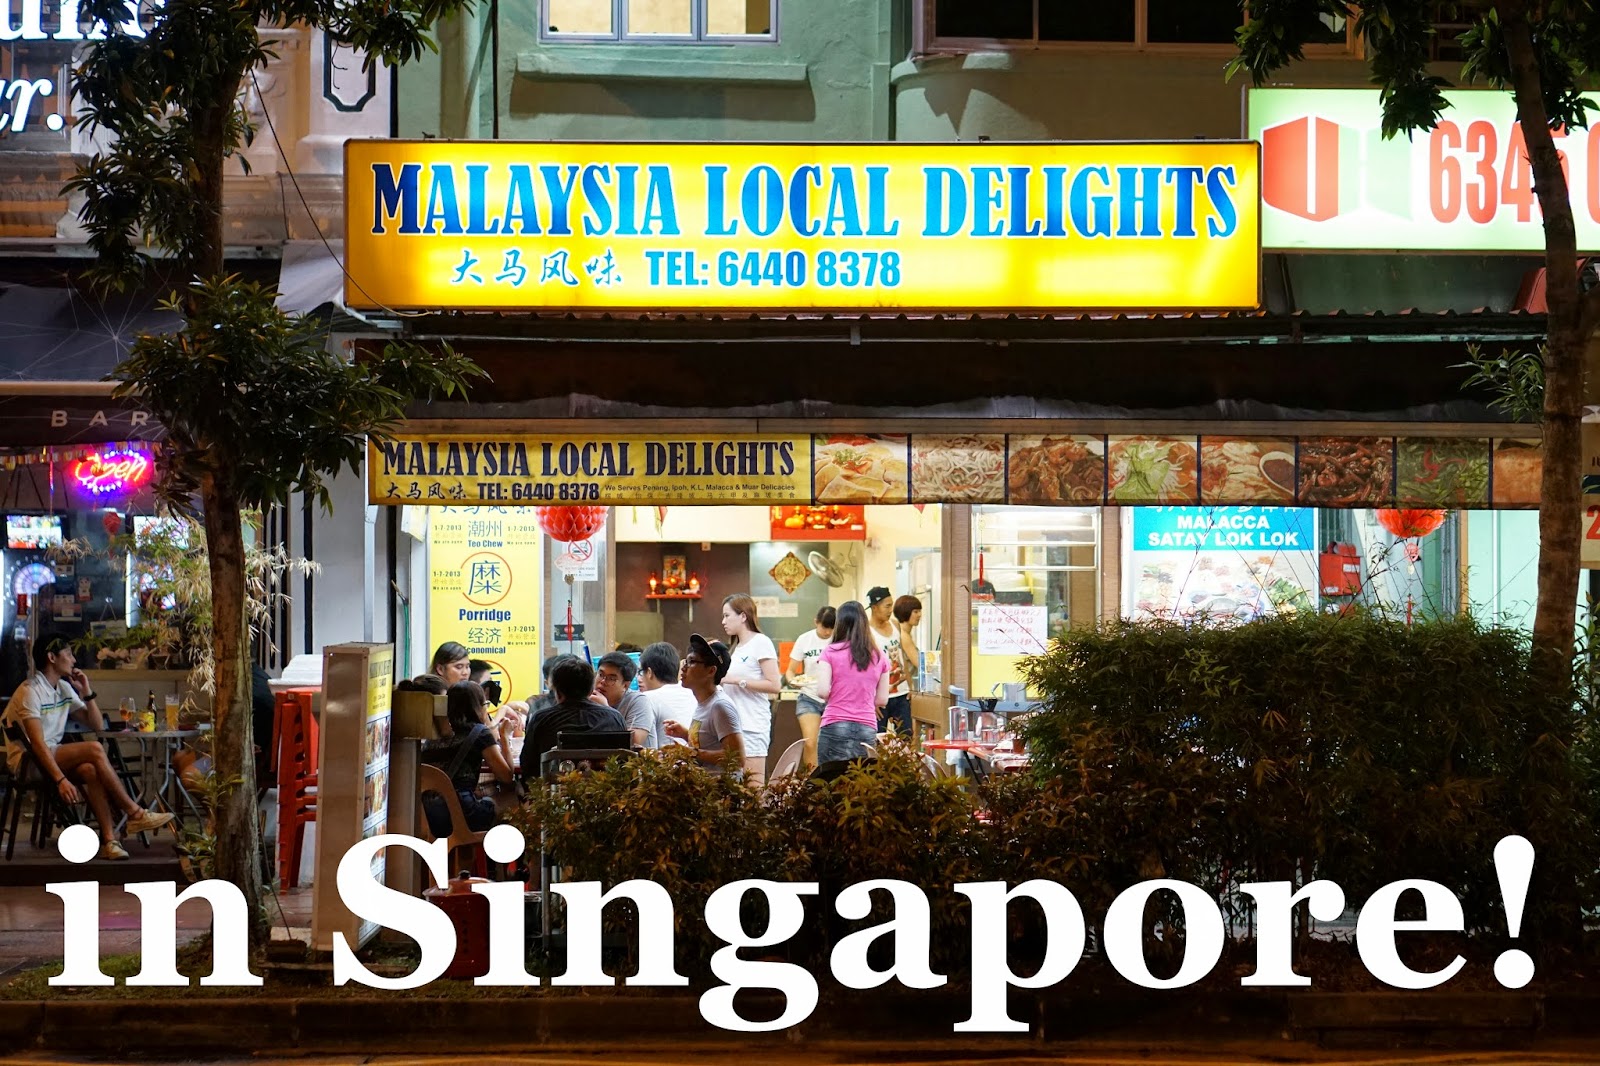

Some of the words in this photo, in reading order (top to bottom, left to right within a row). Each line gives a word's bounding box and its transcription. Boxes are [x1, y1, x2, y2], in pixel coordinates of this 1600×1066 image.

[371, 163, 681, 236] MALAYSIA
[704, 165, 900, 237] LOCAL
[922, 165, 1238, 238] DELIGHTS
[451, 248, 622, 286] 大马风味
[645, 250, 708, 286] TEL:
[717, 250, 807, 286] 6440
[816, 251, 901, 287] 8378
[51, 410, 149, 427] BAR
[383, 441, 531, 476] MALAYSIA
[541, 441, 635, 477] LOCAL
[645, 441, 795, 477] DELIGHTS
[386, 481, 467, 500] 大马风味
[477, 483, 508, 500] TEL:
[512, 483, 554, 500] 6440
[559, 483, 600, 500] 8378
[468, 520, 503, 538] 潮州
[1176, 515, 1271, 529] MALACCA
[468, 540, 481, 548] Teo
[482, 540, 503, 548] Chew
[1147, 532, 1212, 547] SATAY
[1214, 532, 1255, 547] LOK
[1259, 531, 1300, 546] LOK
[458, 608, 511, 623] Porridge
[467, 627, 502, 644] 经济
[464, 646, 506, 654] conomical
